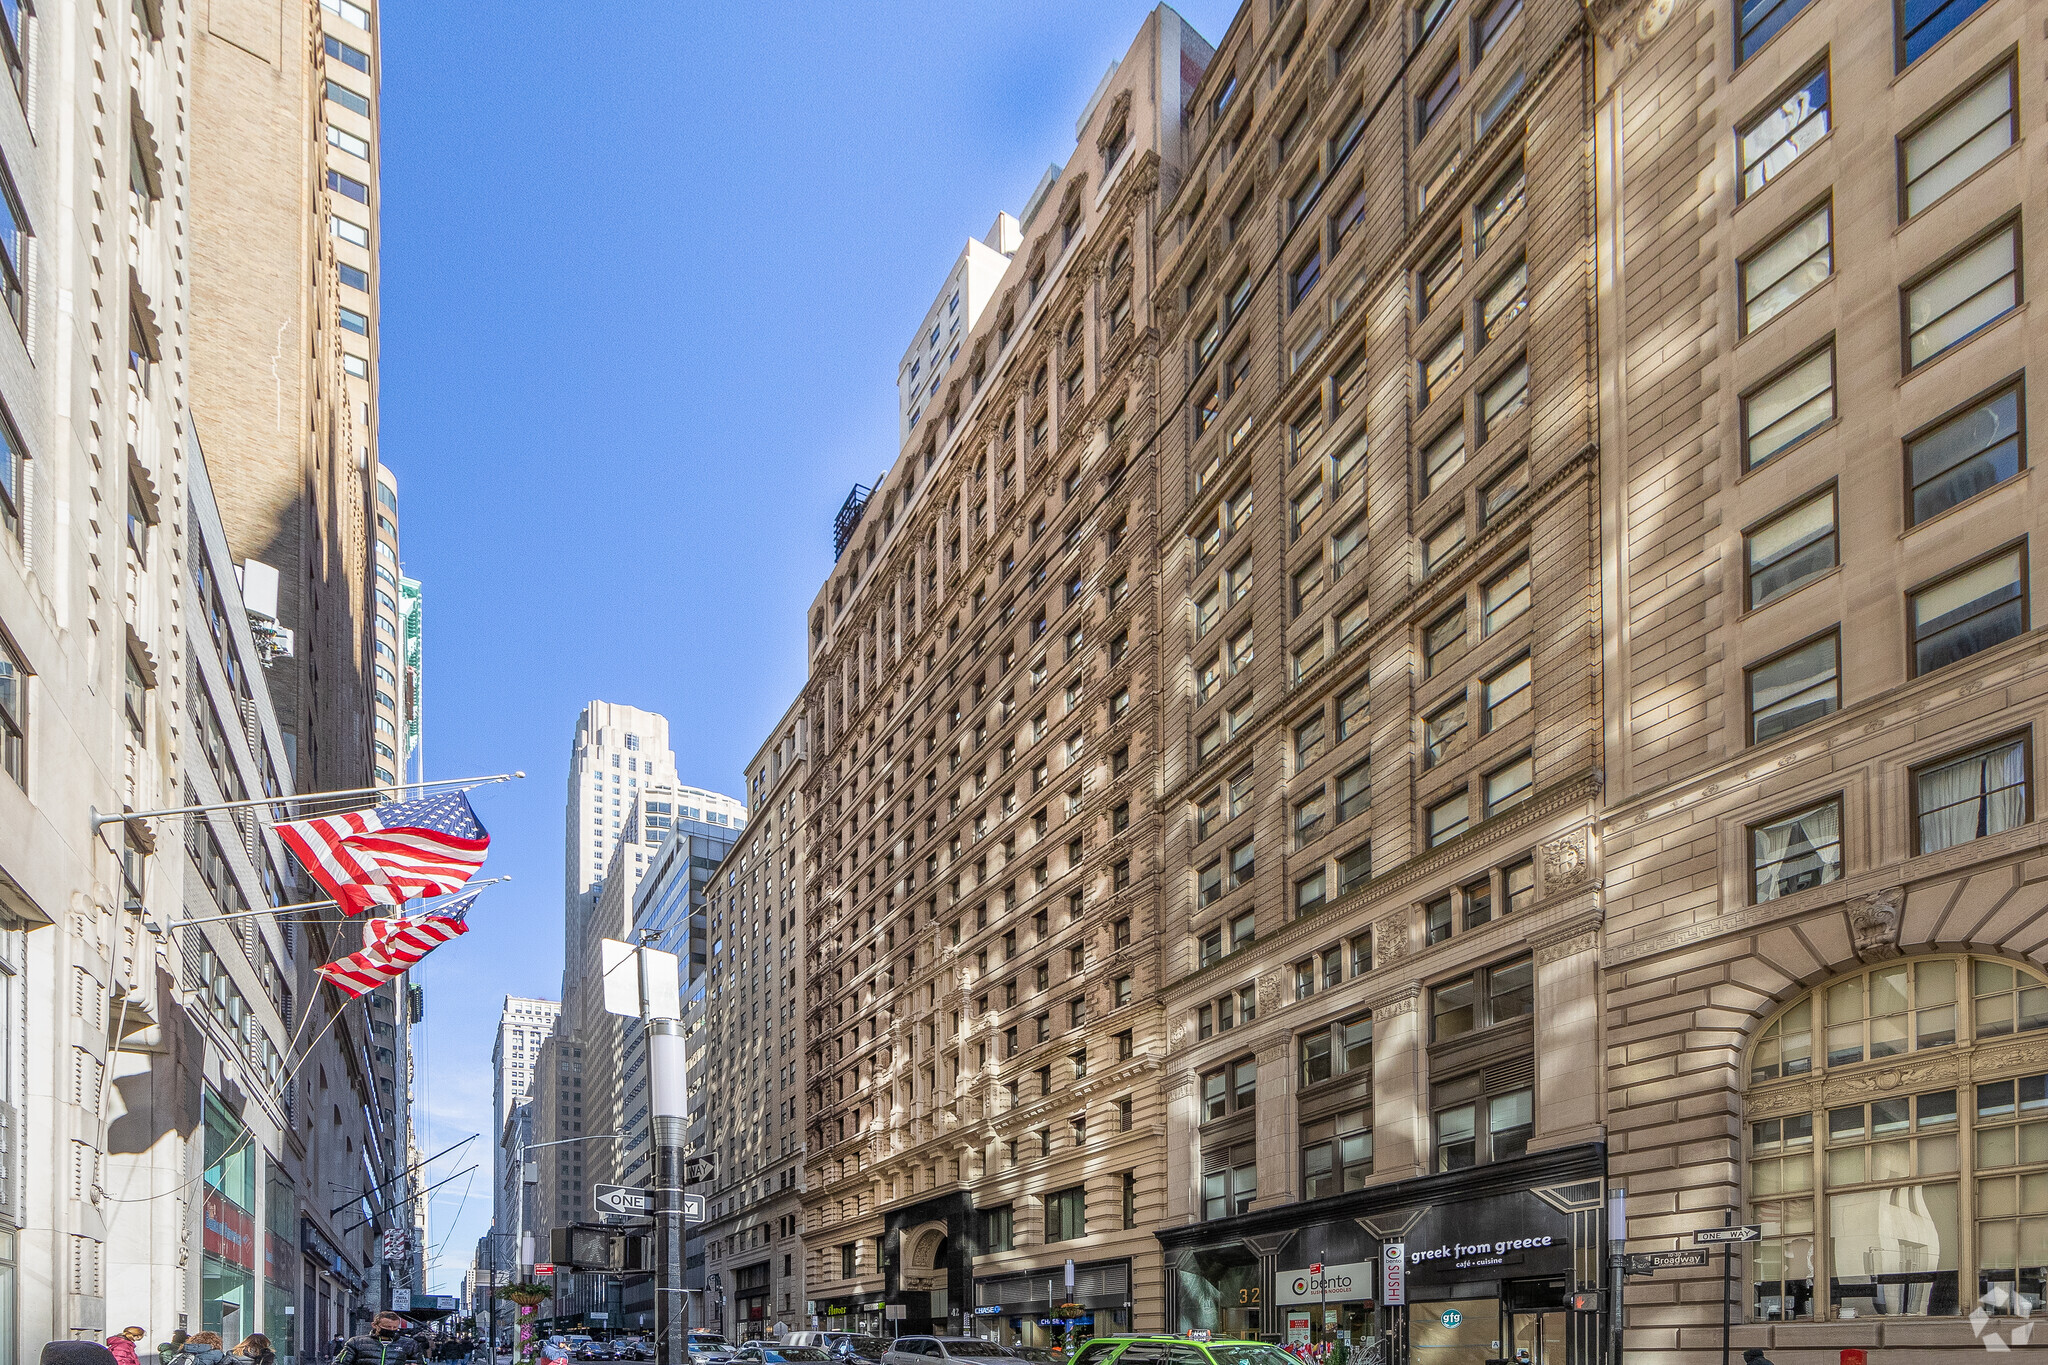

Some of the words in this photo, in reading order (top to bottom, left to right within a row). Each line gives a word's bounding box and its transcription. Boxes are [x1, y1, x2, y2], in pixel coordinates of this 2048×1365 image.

[688, 1163, 708, 1178] WAY
[611, 1194, 644, 1208] ONE
[1730, 1230, 1751, 1238] WAY
[1411, 1245, 1451, 1264] greek
[1453, 1243, 1491, 1259] from
[1494, 1235, 1552, 1255] greece
[1455, 1259, 1471, 1268] café
[1476, 1257, 1503, 1266] cuisine
[1654, 1255, 1701, 1266] Broadway
[1310, 1275, 1352, 1290] bento
[1387, 1265, 1400, 1301] SUSHI
[1239, 1287, 1260, 1304] 32
[974, 1307, 995, 1315] CHASE
[1443, 1312, 1461, 1323] gfg
